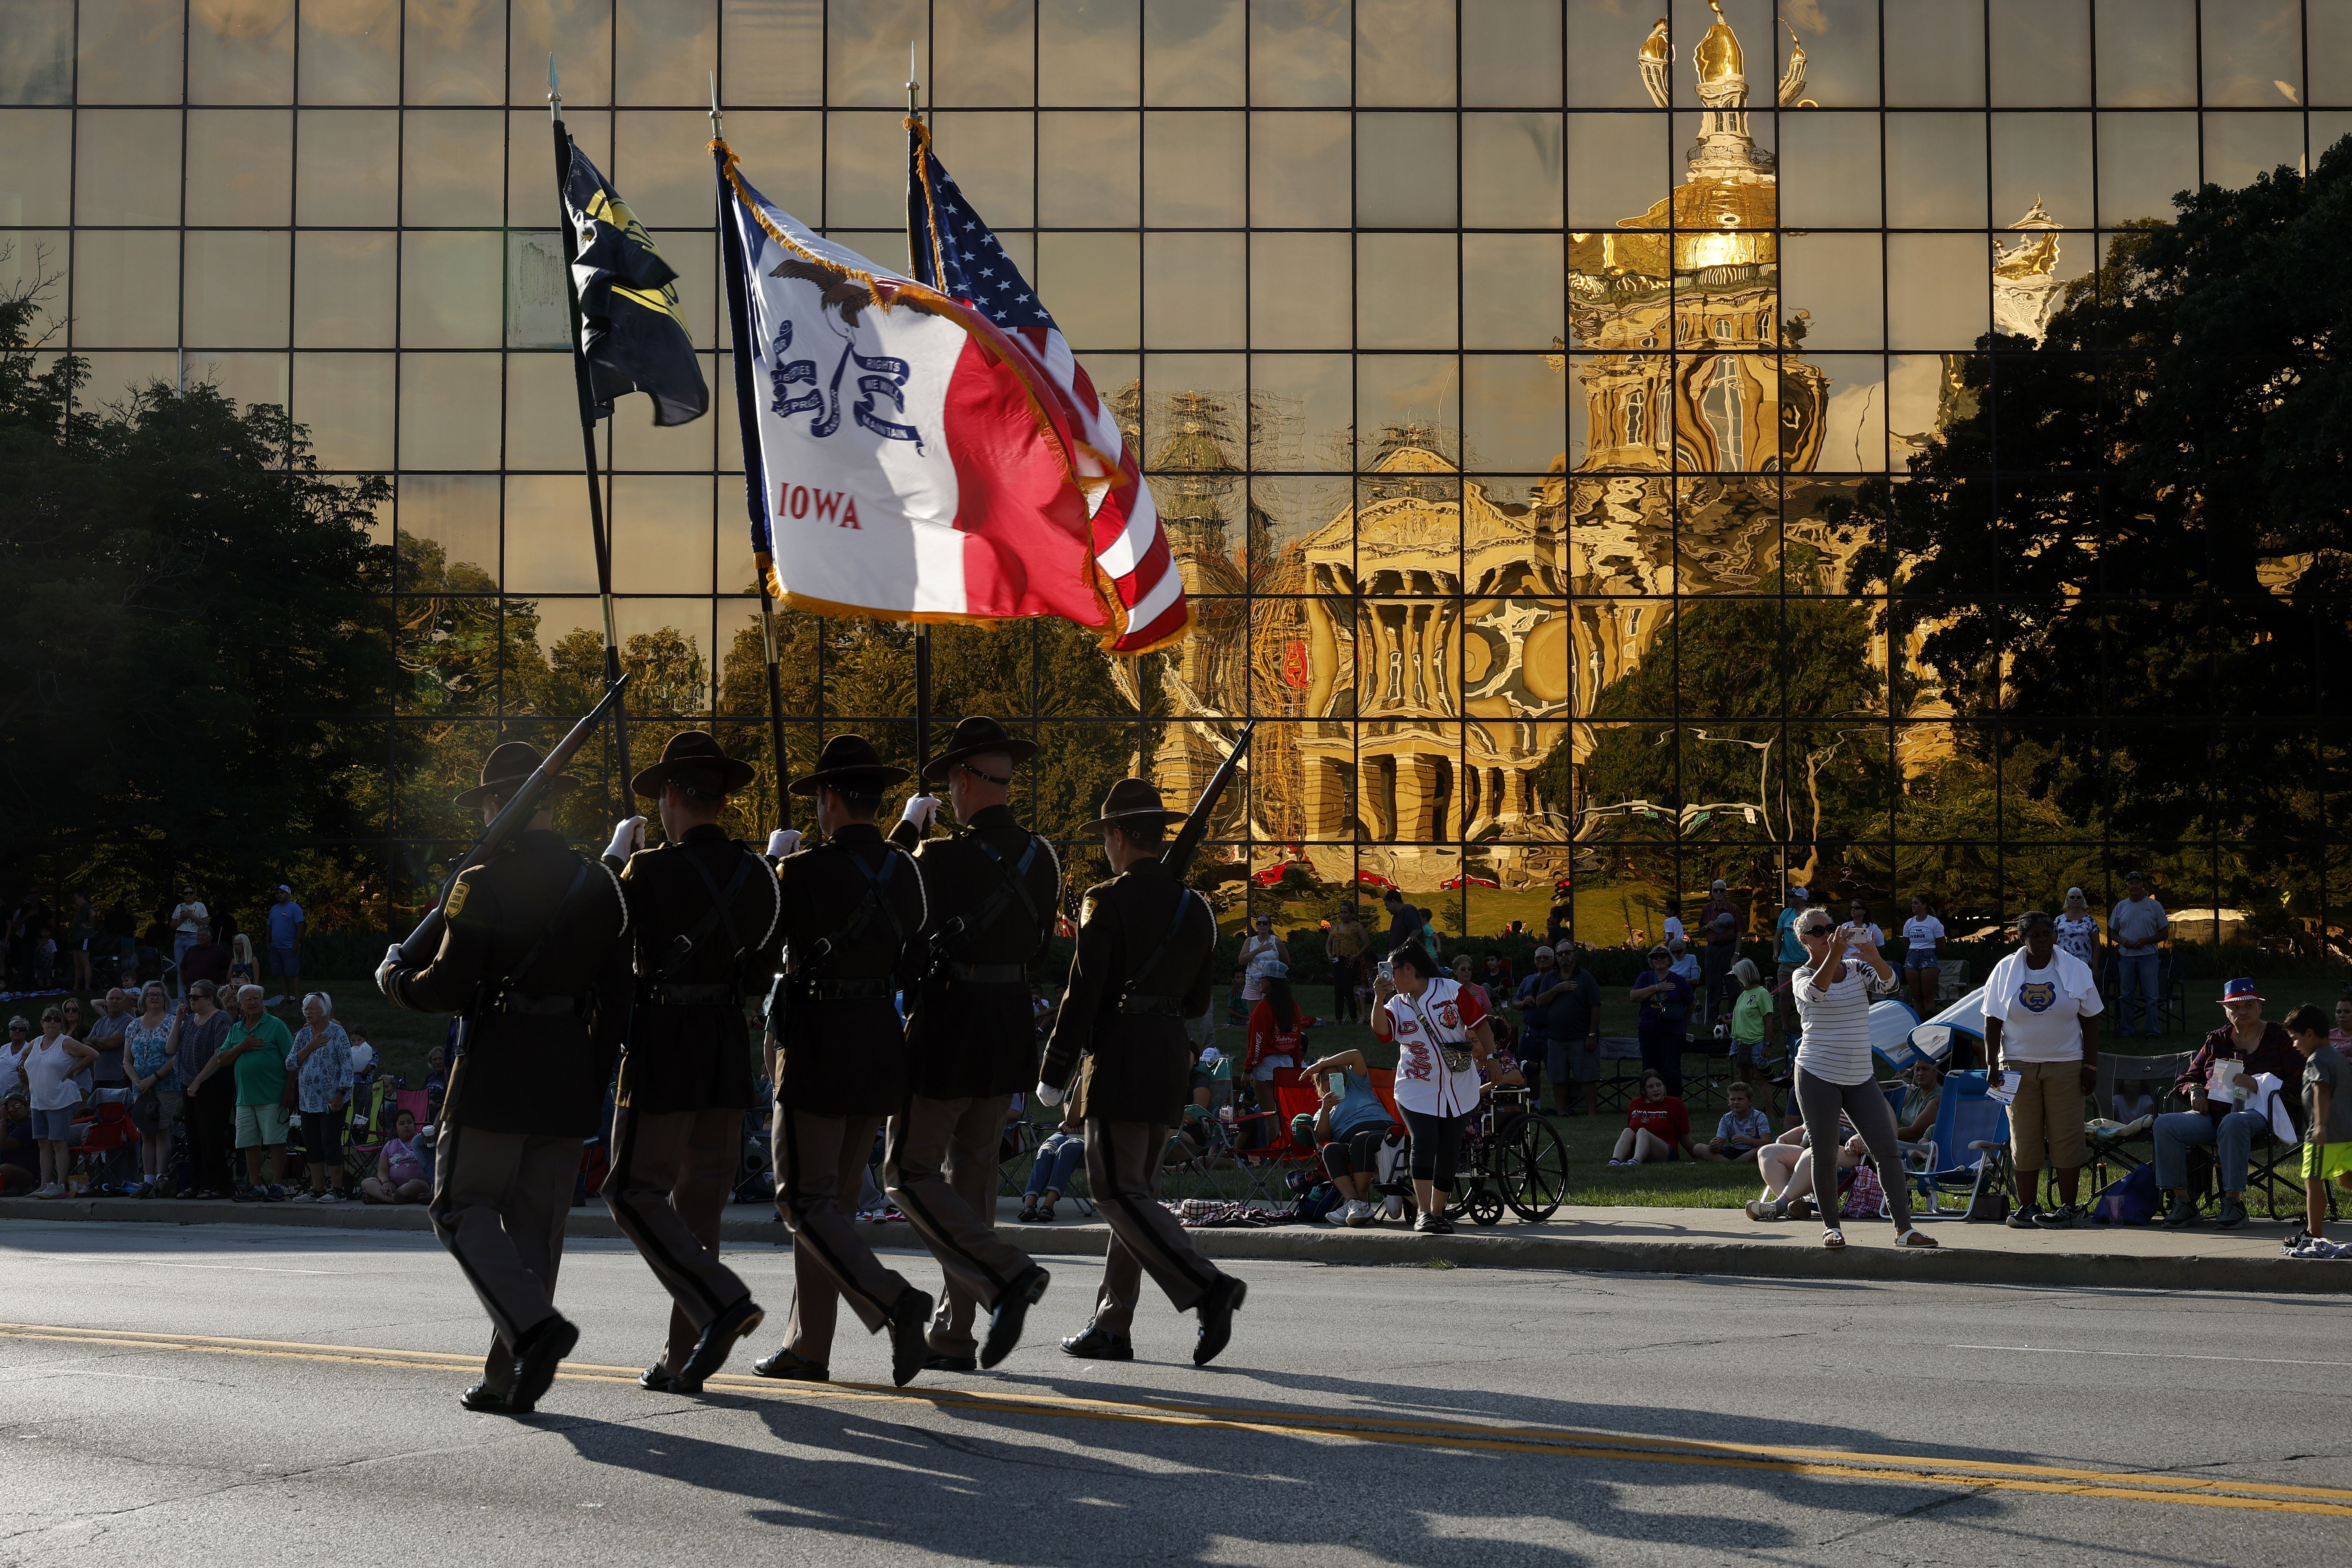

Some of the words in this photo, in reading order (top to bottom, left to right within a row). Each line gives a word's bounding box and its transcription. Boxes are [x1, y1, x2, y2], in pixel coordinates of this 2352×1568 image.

[774, 339, 787, 353] OUR
[772, 365, 811, 382] LIBERTIES
[866, 359, 901, 372] RIGHTS
[864, 379, 879, 390] WE
[880, 380, 899, 401] WILL
[791, 394, 821, 410] PRIZE
[862, 414, 909, 439] MAINTAIN
[777, 482, 864, 530] IOWA
